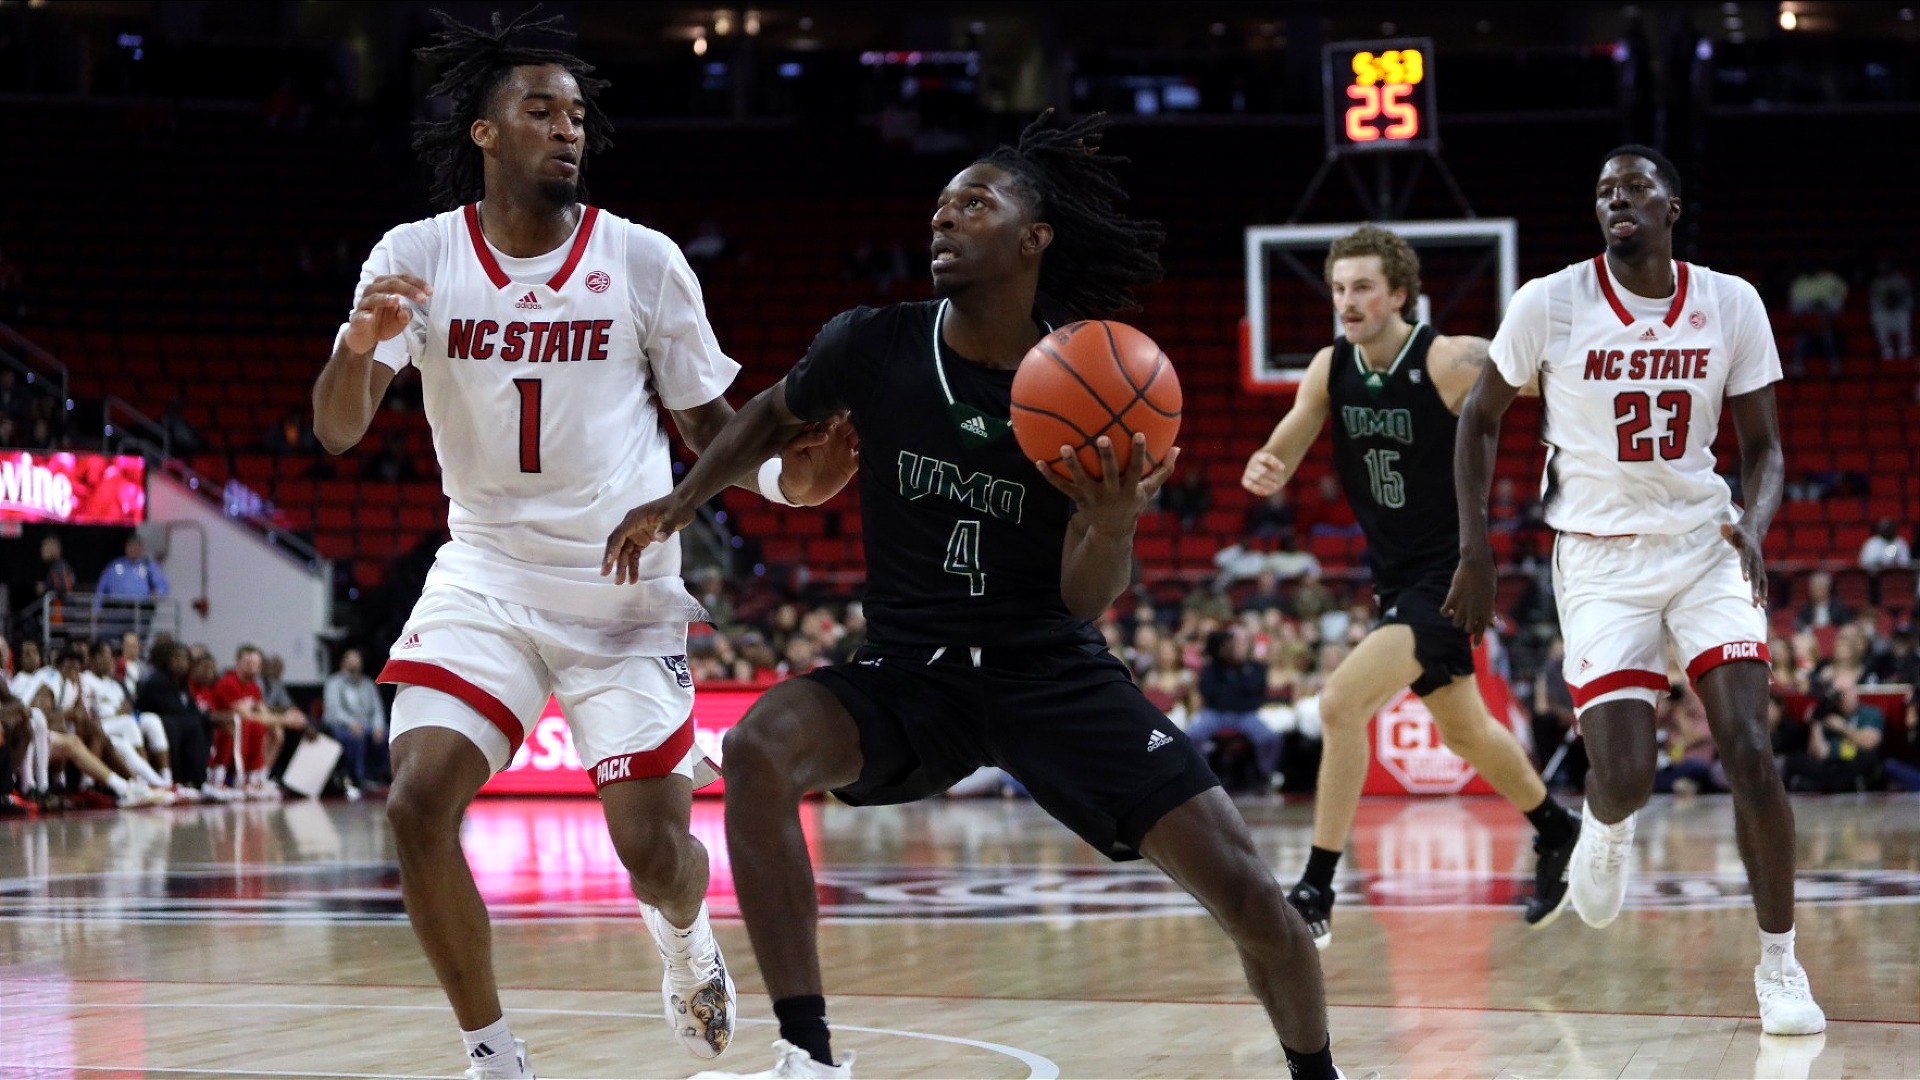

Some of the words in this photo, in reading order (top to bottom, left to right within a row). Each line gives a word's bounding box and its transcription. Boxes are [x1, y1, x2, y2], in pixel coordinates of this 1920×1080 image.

[1346, 84, 1418, 141] 25
[515, 301, 542, 310] adidas
[447, 318, 499, 360] NC
[500, 319, 614, 362] STATE
[1584, 349, 1625, 380] NC
[1628, 348, 1711, 380] STATE
[512, 378, 542, 473] 1
[961, 423, 988, 438] adidas
[1342, 405, 1414, 445] UMO
[1613, 389, 1692, 462] 23
[898, 450, 1026, 524] UMO
[1363, 448, 1405, 508] 15
[944, 520, 987, 596] 4
[1722, 642, 1759, 660] PACK
[1147, 736, 1174, 752] adidas
[597, 757, 634, 785] PACK
